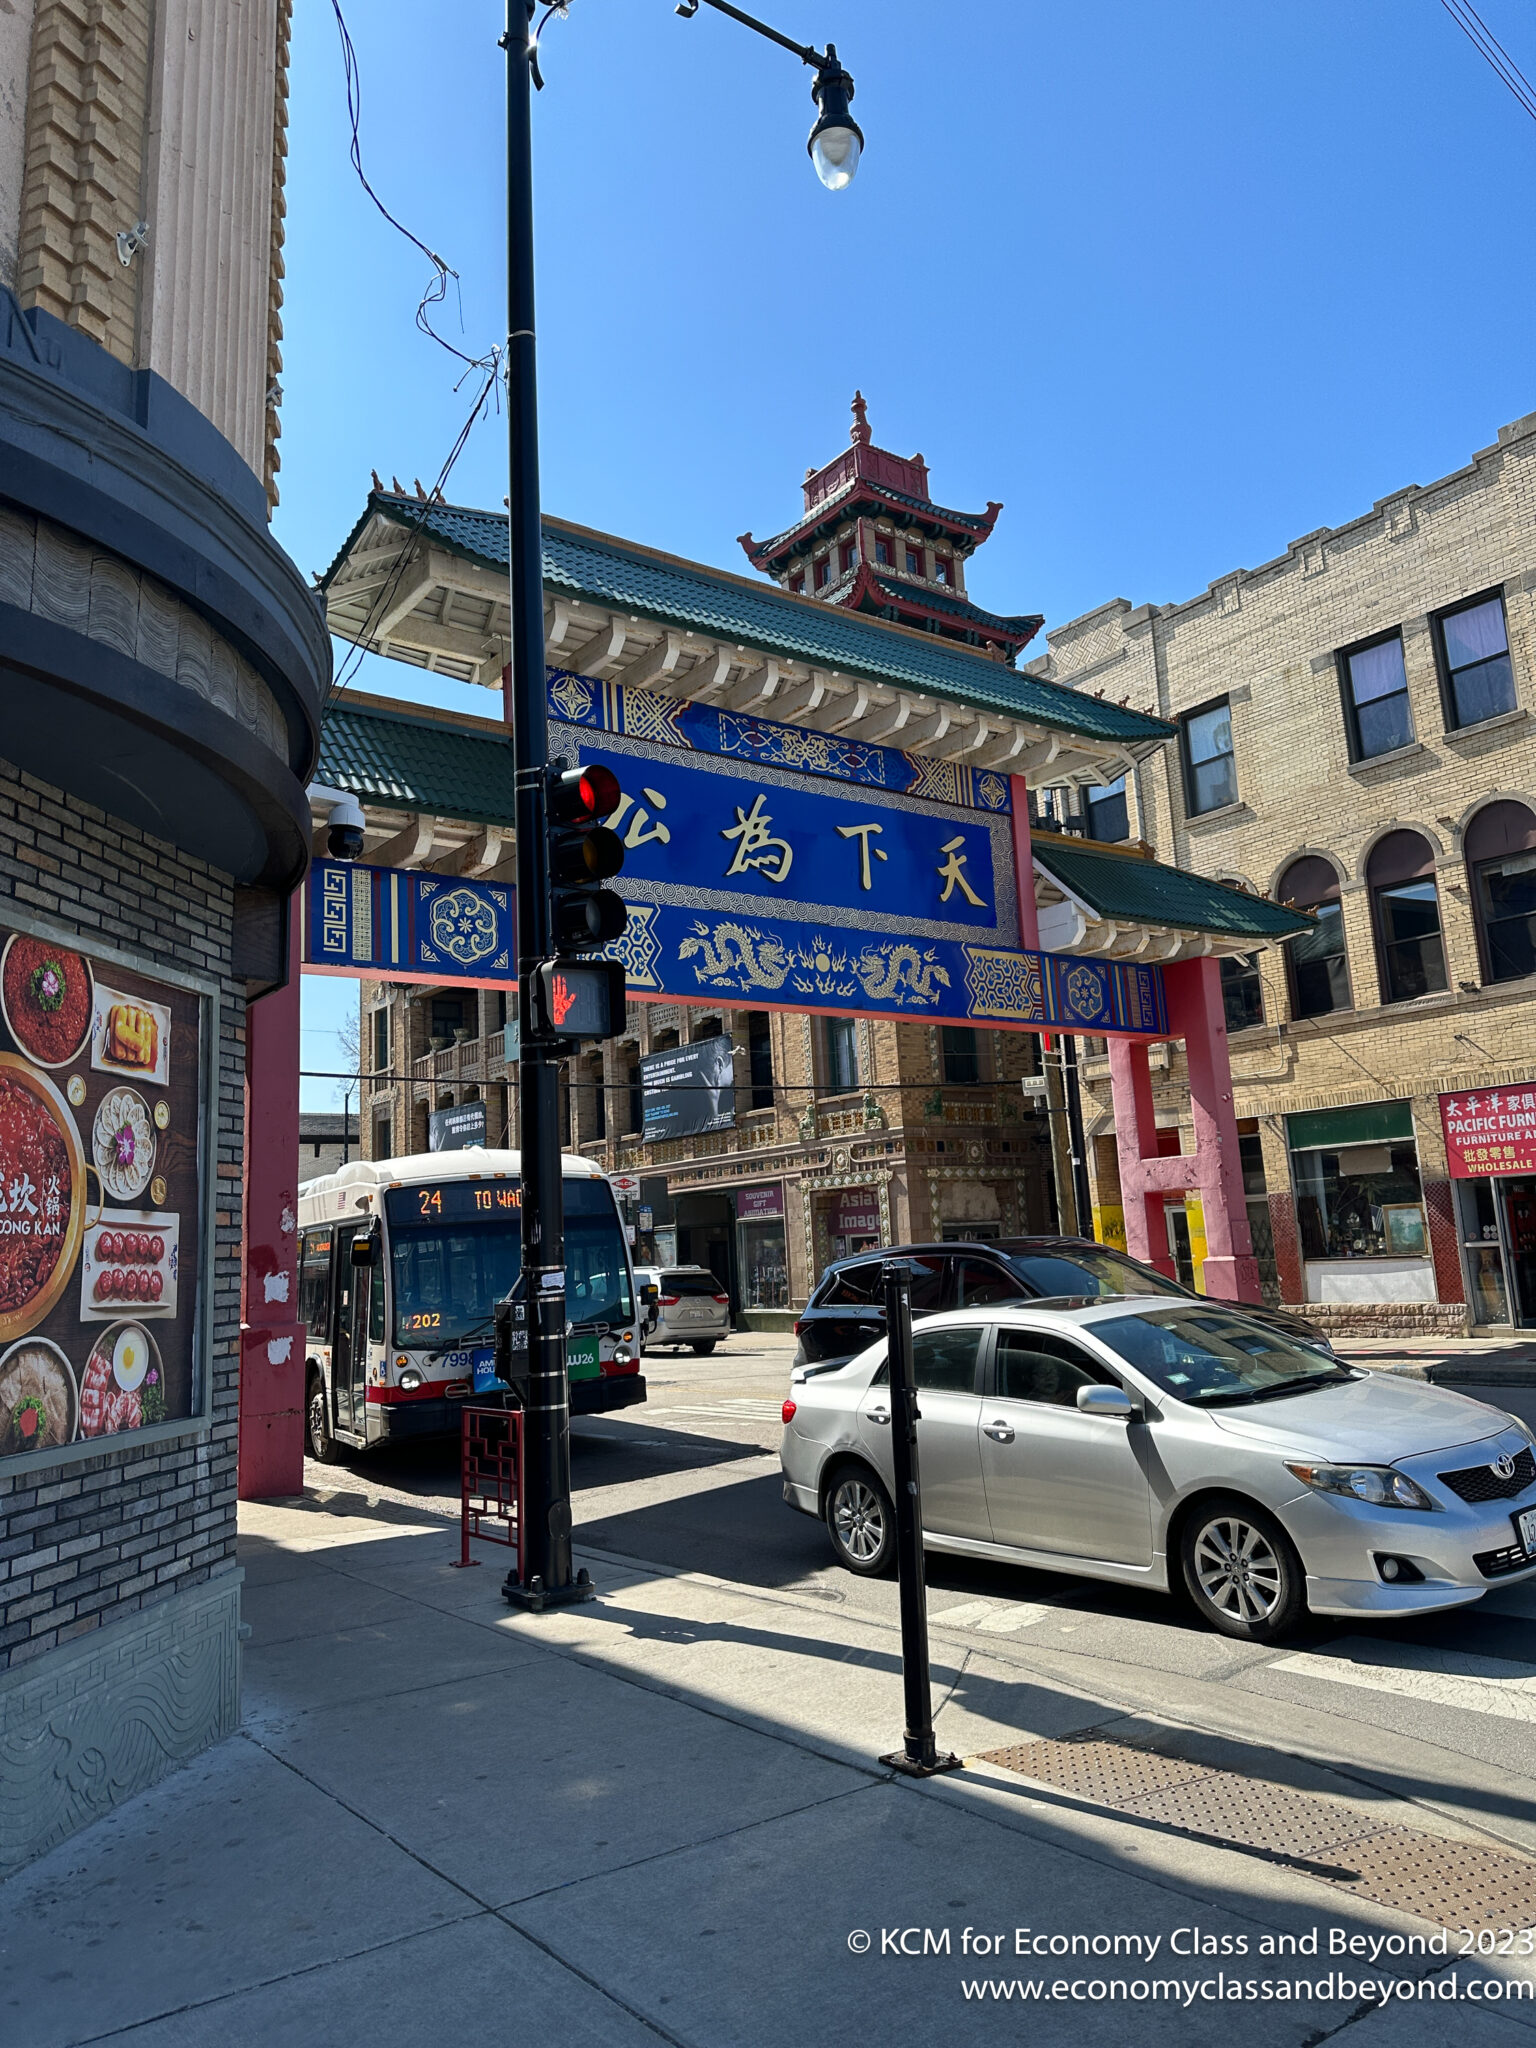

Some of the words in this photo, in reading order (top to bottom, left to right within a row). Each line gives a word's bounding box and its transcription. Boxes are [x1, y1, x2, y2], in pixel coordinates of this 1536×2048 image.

[685, 1053, 699, 1062] EVERY
[1447, 1116, 1497, 1134] PACIFIC
[1498, 1111, 1536, 1129] FURN
[1456, 1131, 1522, 1146] FURNITURE
[1467, 1159, 1533, 1173] WHOLESALE
[418, 1190, 442, 1215] 24
[474, 1190, 492, 1210] TO
[496, 1188, 522, 1208] WAC
[34, 1220, 60, 1236] KAN
